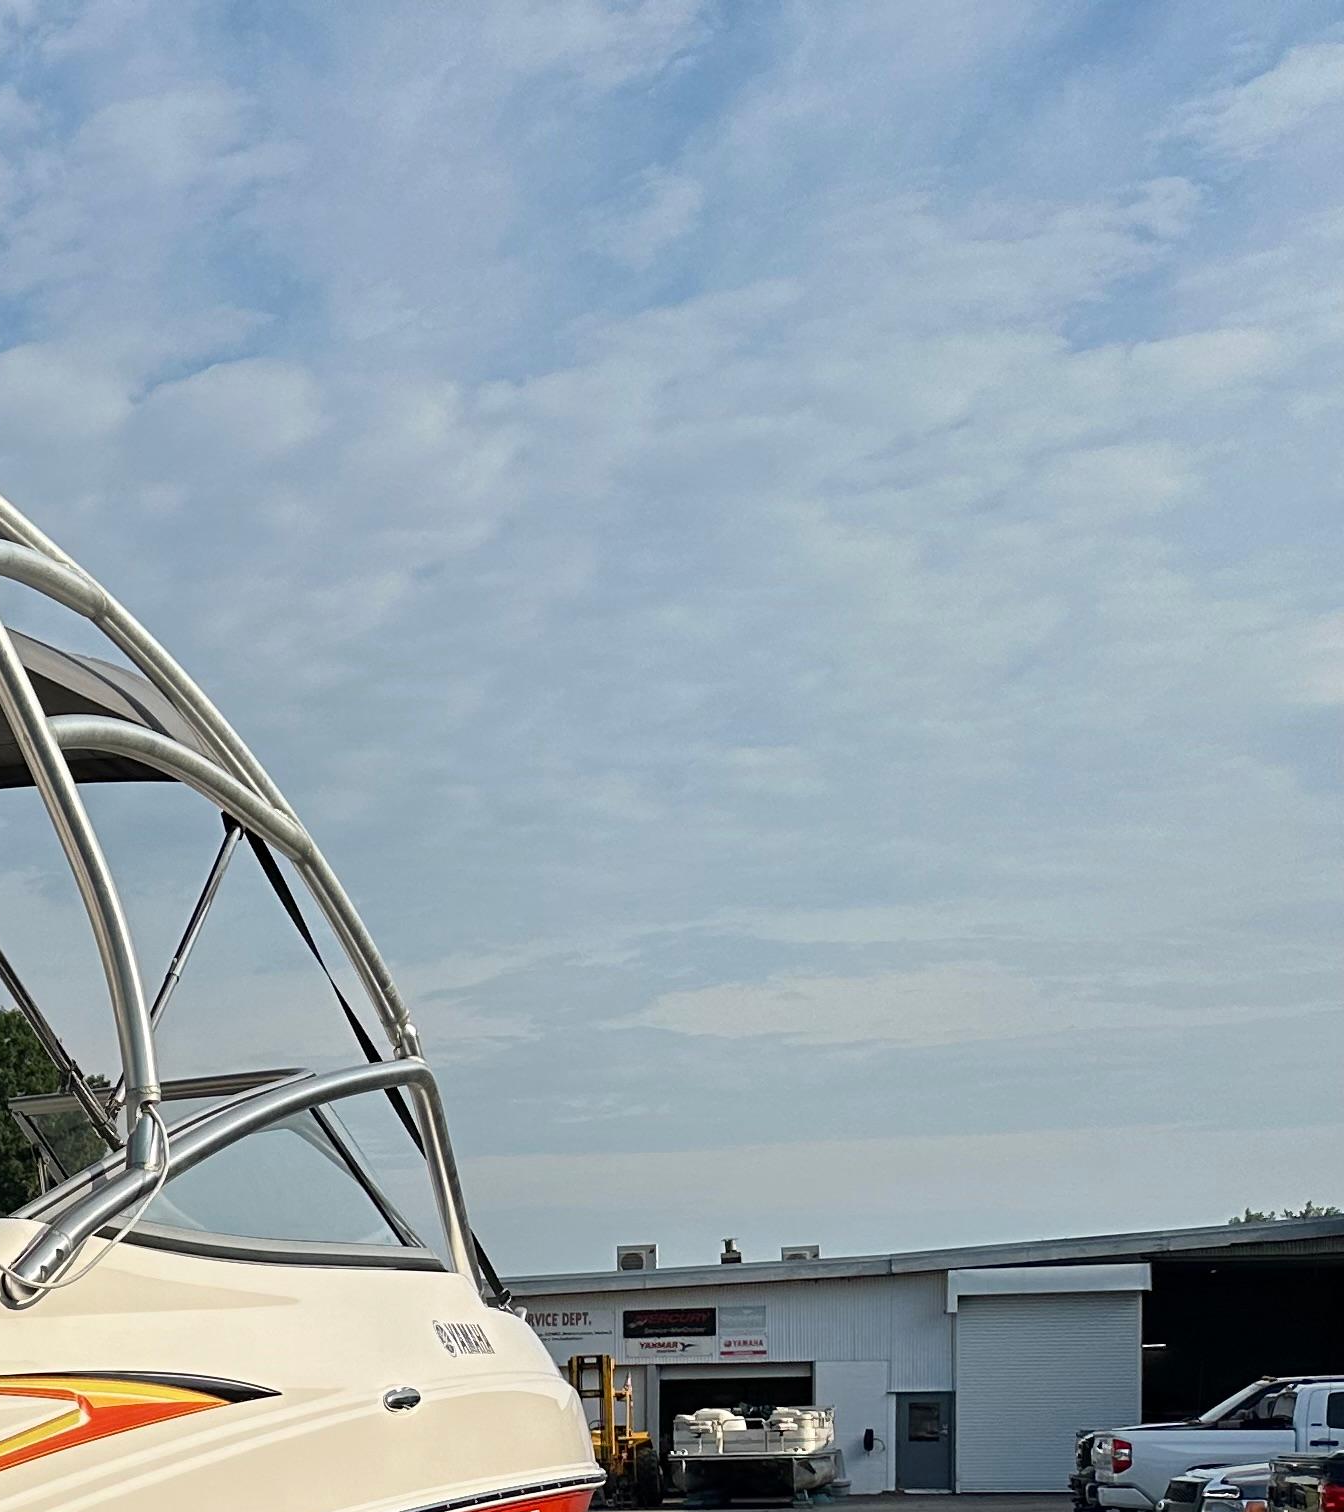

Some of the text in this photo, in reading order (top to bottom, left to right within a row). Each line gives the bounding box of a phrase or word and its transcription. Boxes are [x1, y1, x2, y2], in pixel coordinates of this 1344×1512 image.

[527, 1312, 592, 1327] RVICE DEPT.
[443, 1323, 496, 1355] YAMAHA
[733, 1338, 764, 1347] YAMAHA
